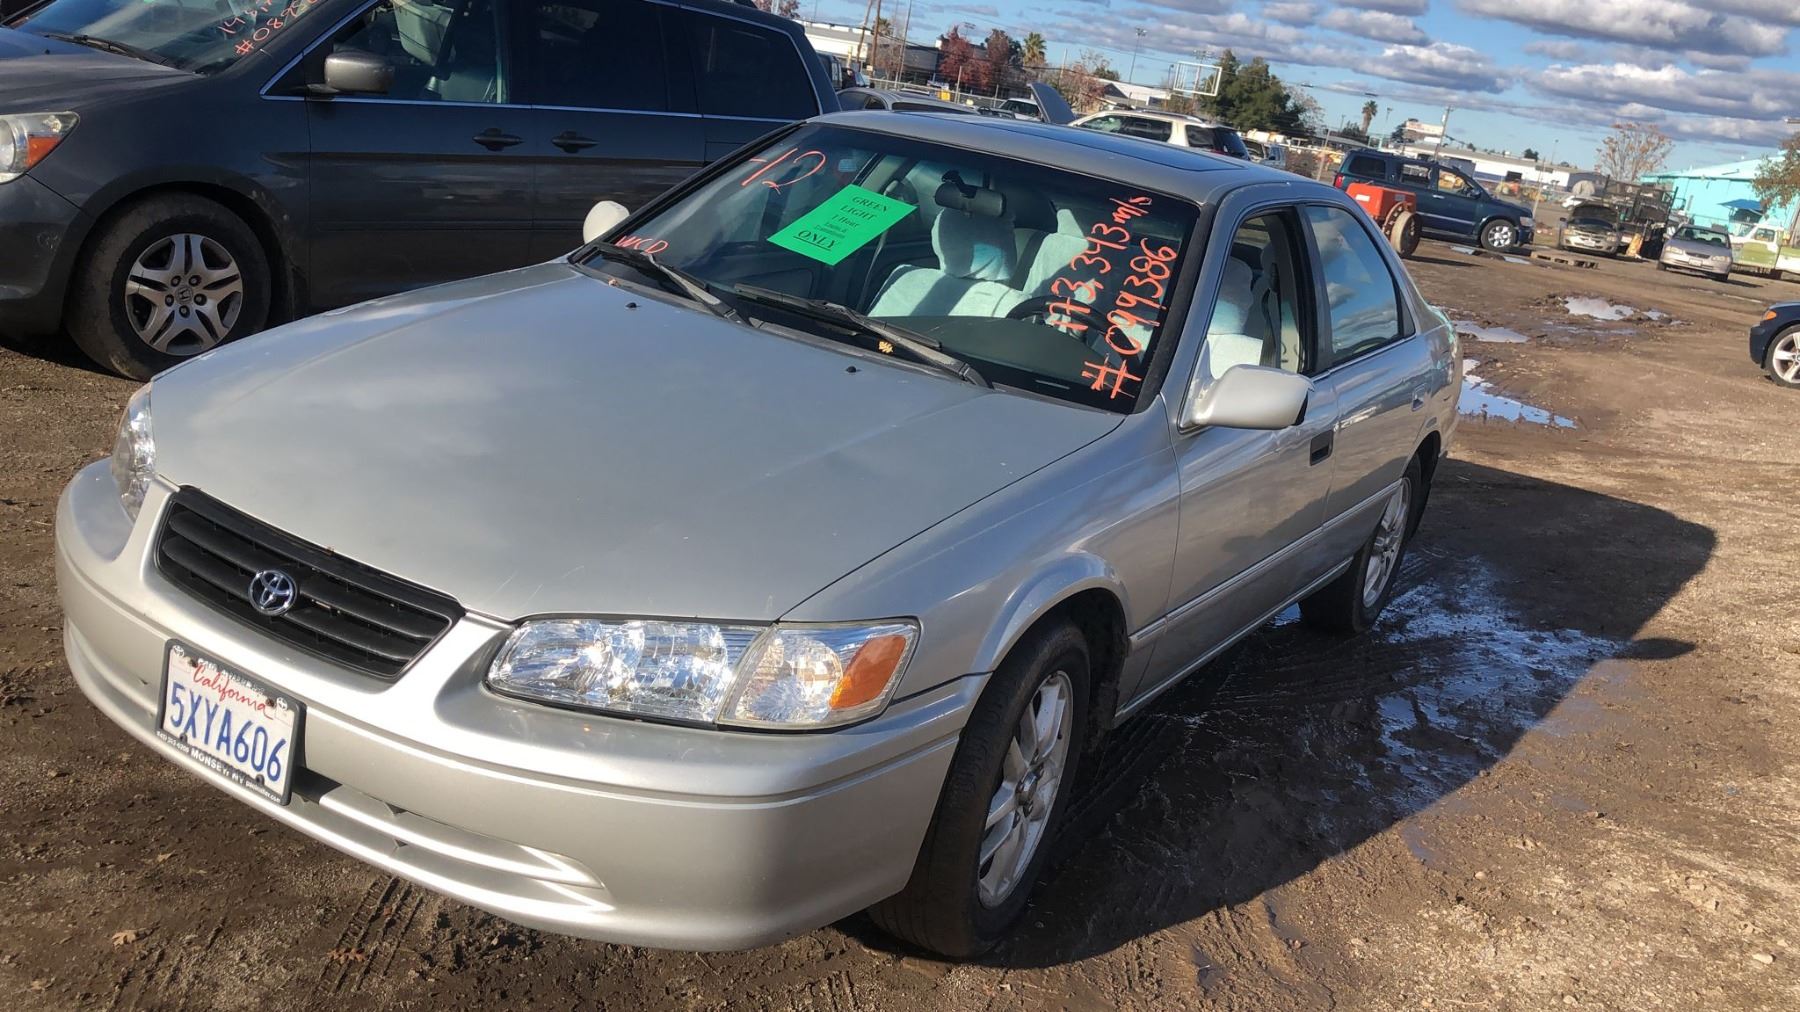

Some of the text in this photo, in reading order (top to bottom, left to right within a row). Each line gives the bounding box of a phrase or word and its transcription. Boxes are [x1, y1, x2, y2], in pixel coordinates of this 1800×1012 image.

[840, 205, 878, 220] LIGHT
[851, 196, 891, 212] GREEN
[615, 235, 669, 254] WCD
[797, 230, 840, 248] ONLY
[1081, 237, 1177, 399] #099386
[193, 664, 274, 720] California
[170, 681, 286, 781] 5XYA606
